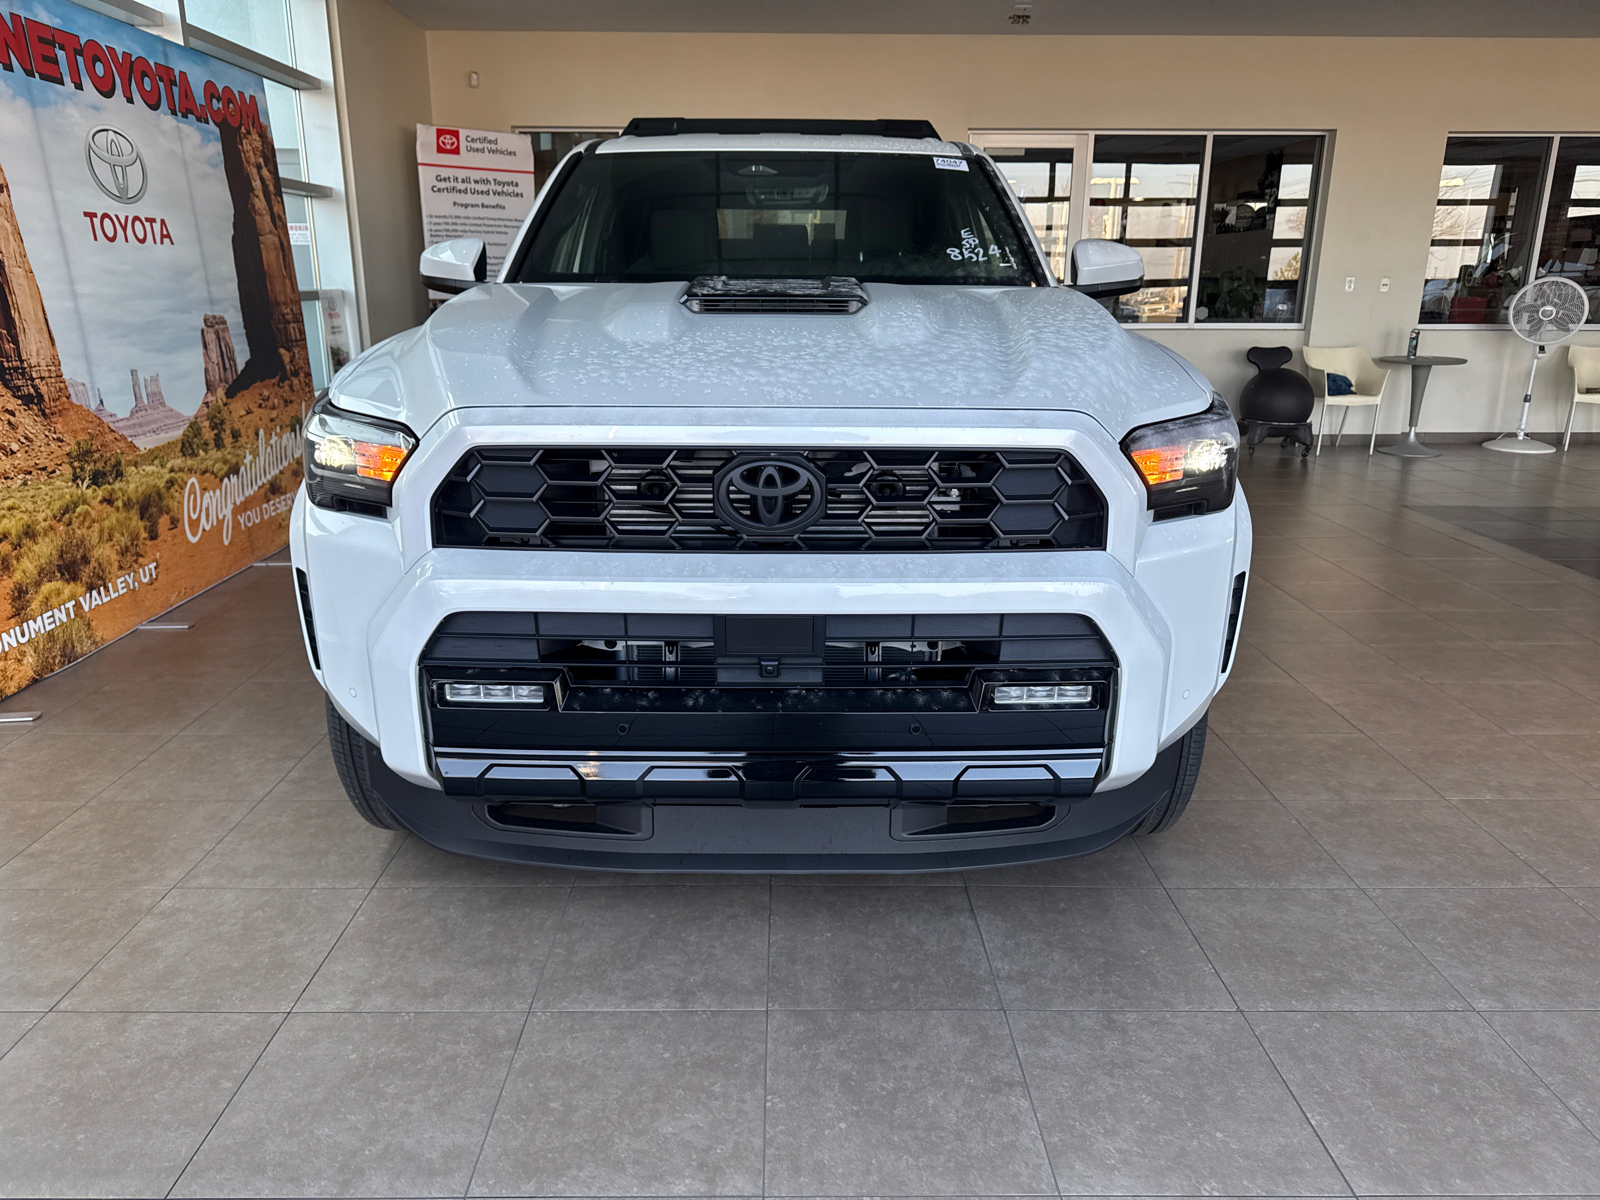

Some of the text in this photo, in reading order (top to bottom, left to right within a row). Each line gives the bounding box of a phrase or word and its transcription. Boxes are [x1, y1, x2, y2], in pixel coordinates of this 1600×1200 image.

[465, 134, 498, 146] Certified
[466, 145, 517, 157] Used Vehicles
[435, 174, 519, 188] Get it all with Toyota
[431, 185, 524, 199] Certified Used Vehicles
[453, 201, 506, 211] Program Benefits
[83, 211, 174, 246] TOYOTA
[183, 424, 303, 546] Congratulations
[237, 506, 261, 531] YOU
[0, 561, 158, 654] NUMENT VALLEY, UT
